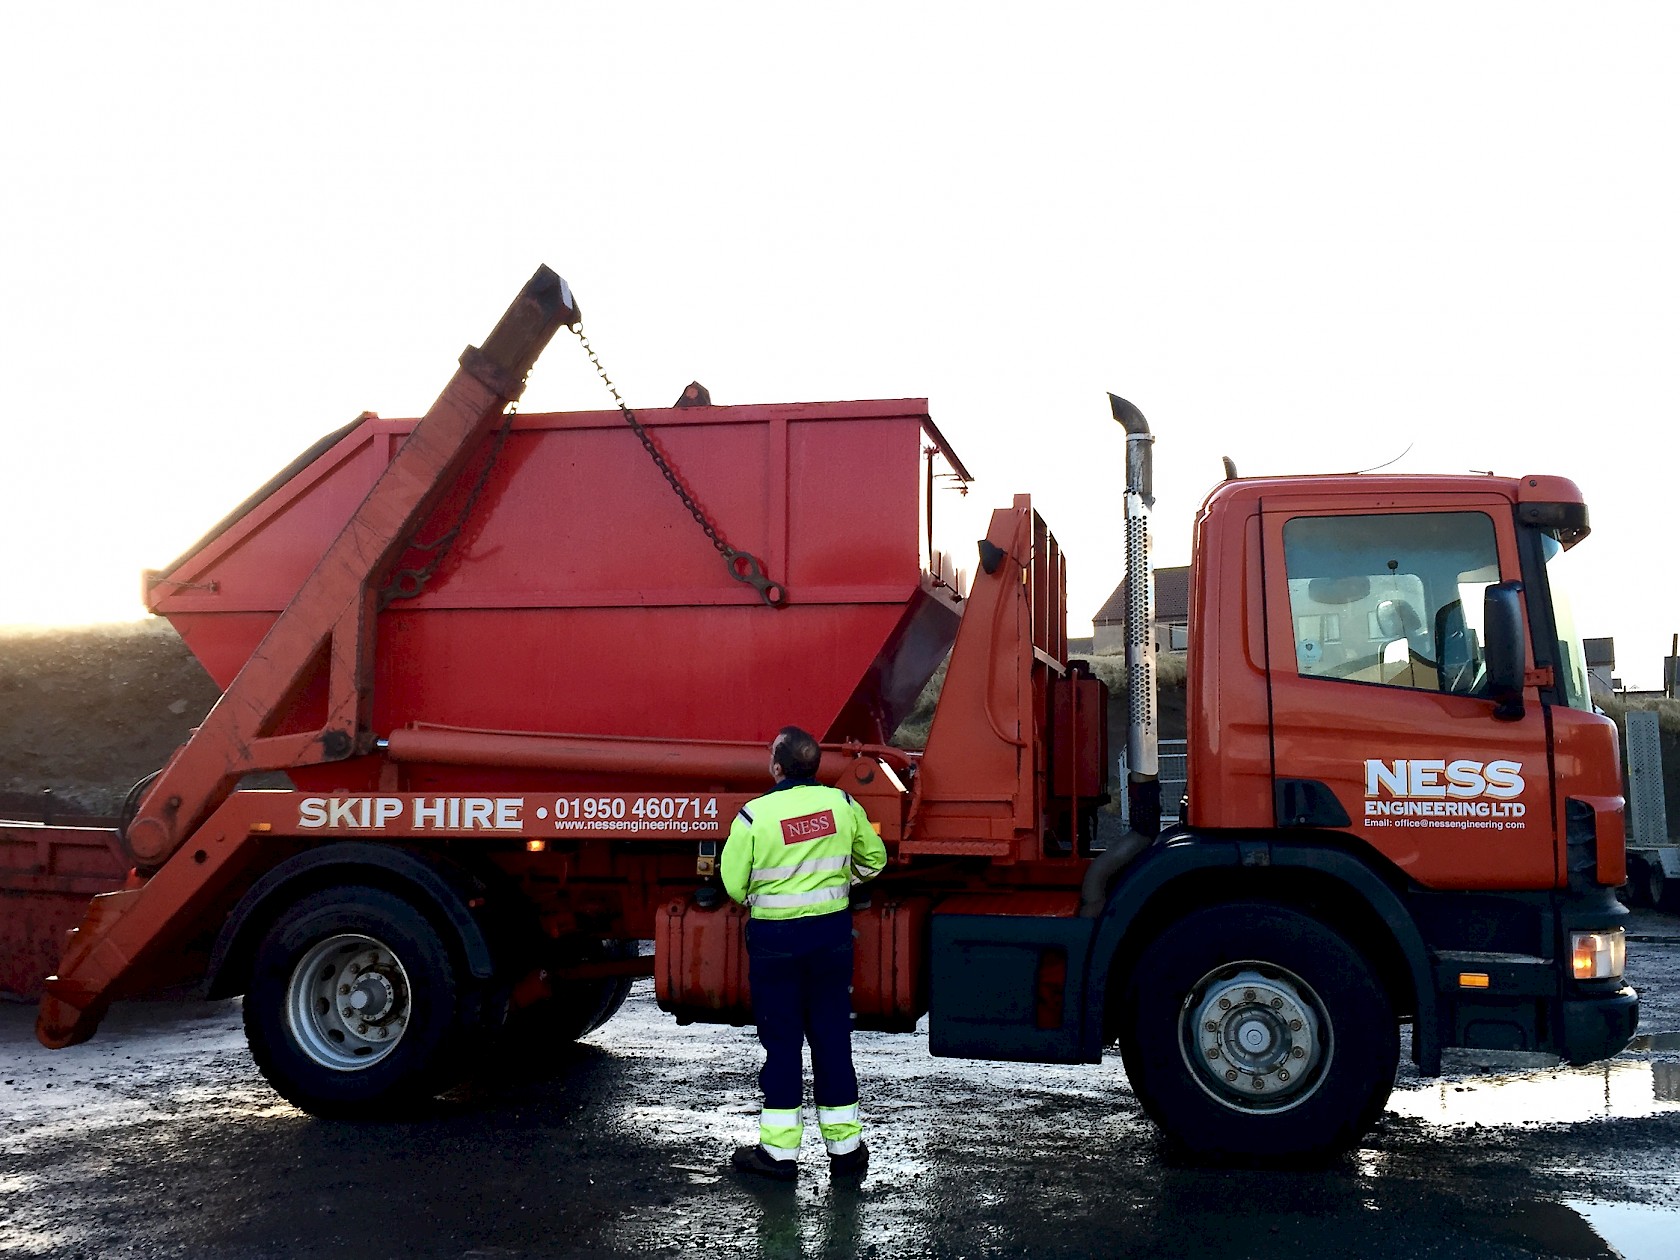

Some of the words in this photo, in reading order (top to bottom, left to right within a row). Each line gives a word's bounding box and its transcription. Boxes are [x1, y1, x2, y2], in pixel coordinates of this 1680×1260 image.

[1364, 759, 1526, 800] NESS
[296, 797, 404, 832] SKIP
[411, 797, 524, 833] HIRE
[555, 797, 626, 819] 01950
[631, 797, 719, 819] 460714
[1364, 801, 1490, 817] ENGINEERING
[1491, 802, 1526, 818] LTD
[555, 819, 719, 833] www.nessengineering.com
[787, 815, 830, 837] NESS
[1364, 818, 1393, 828] Email:
